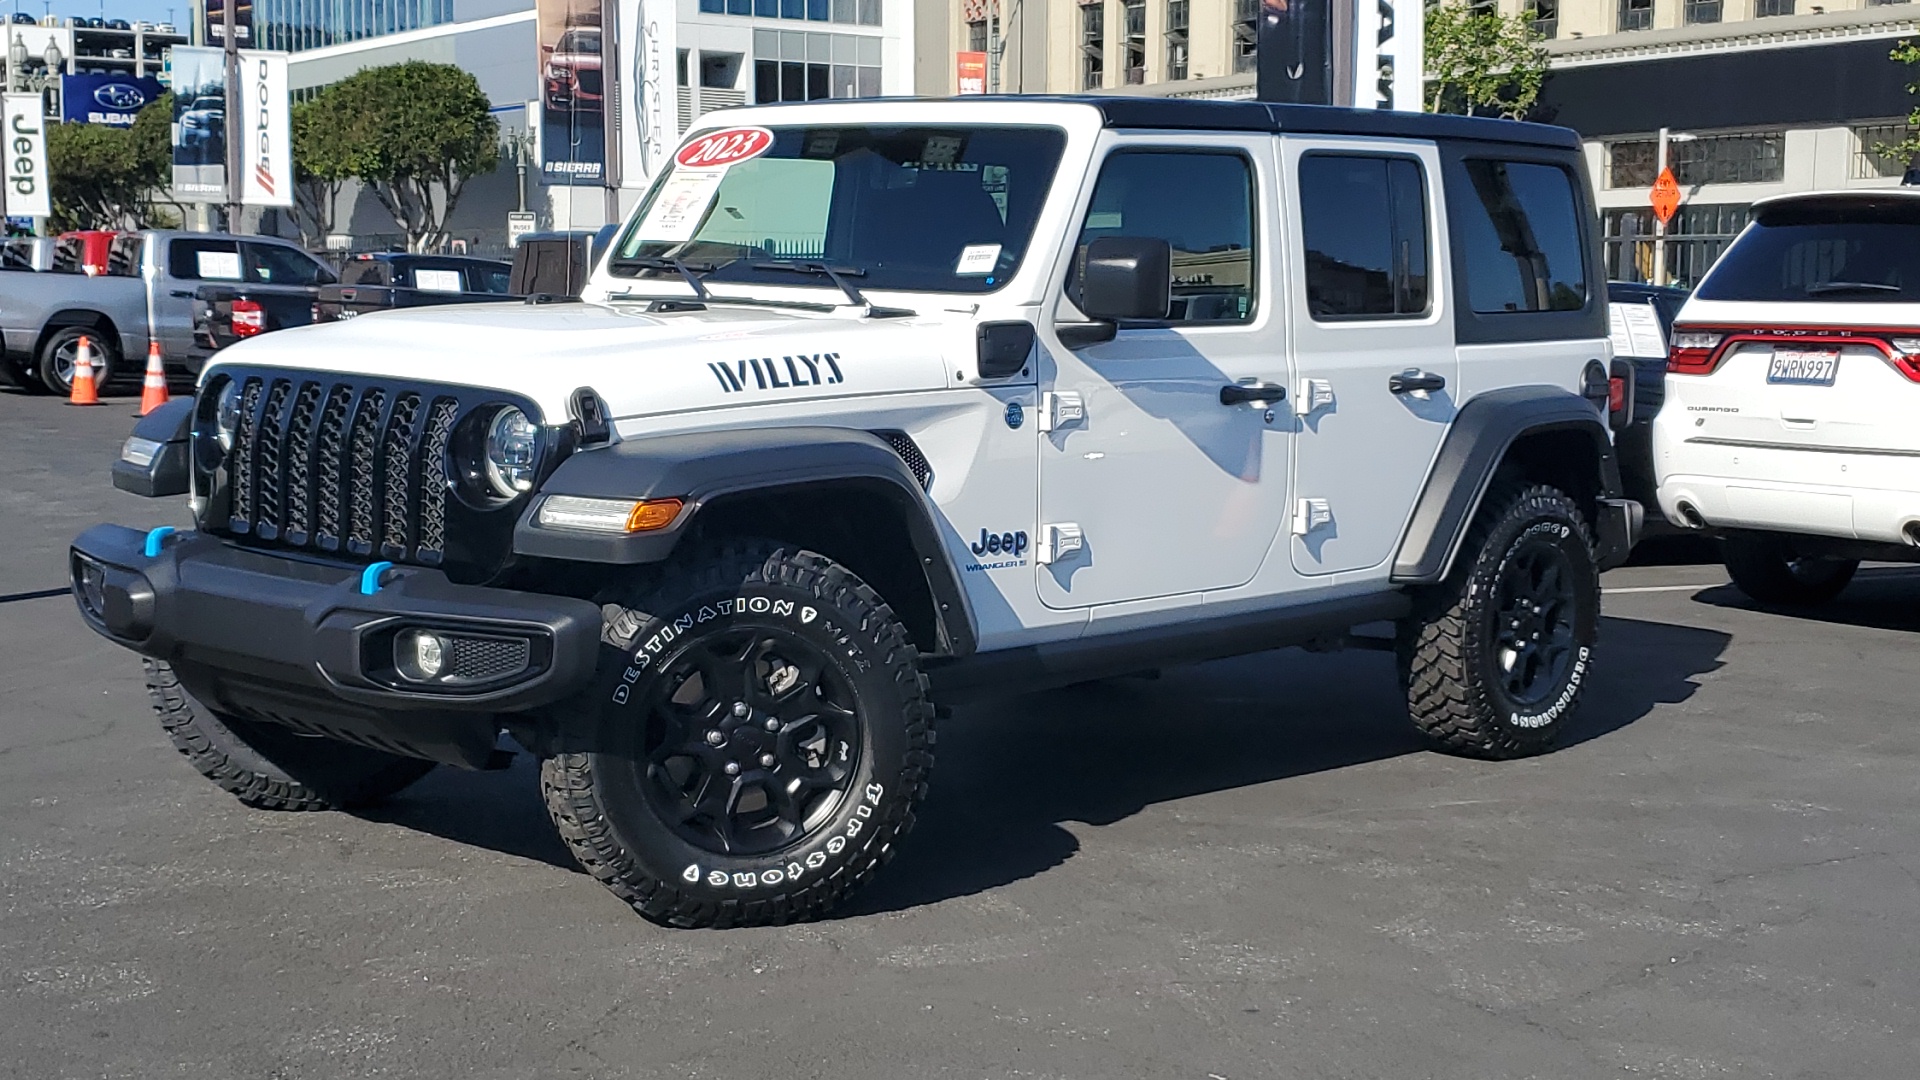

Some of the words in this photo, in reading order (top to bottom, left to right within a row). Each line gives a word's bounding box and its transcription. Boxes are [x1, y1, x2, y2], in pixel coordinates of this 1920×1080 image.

[1376, 0, 1394, 109] AM
[257, 60, 270, 176] DODGE
[650, 21, 661, 155] CHRYSLER
[9, 114, 39, 195] Jeep
[554, 162, 601, 173] SIERRA
[685, 131, 761, 164] 2023
[707, 353, 844, 393] WILLYS
[1772, 360, 1833, 381] 9WRN997
[966, 560, 1017, 572] WRANGLER
[971, 528, 1028, 557] Jeep
[612, 596, 794, 704] DESTINATION
[707, 783, 884, 887] Firestone
